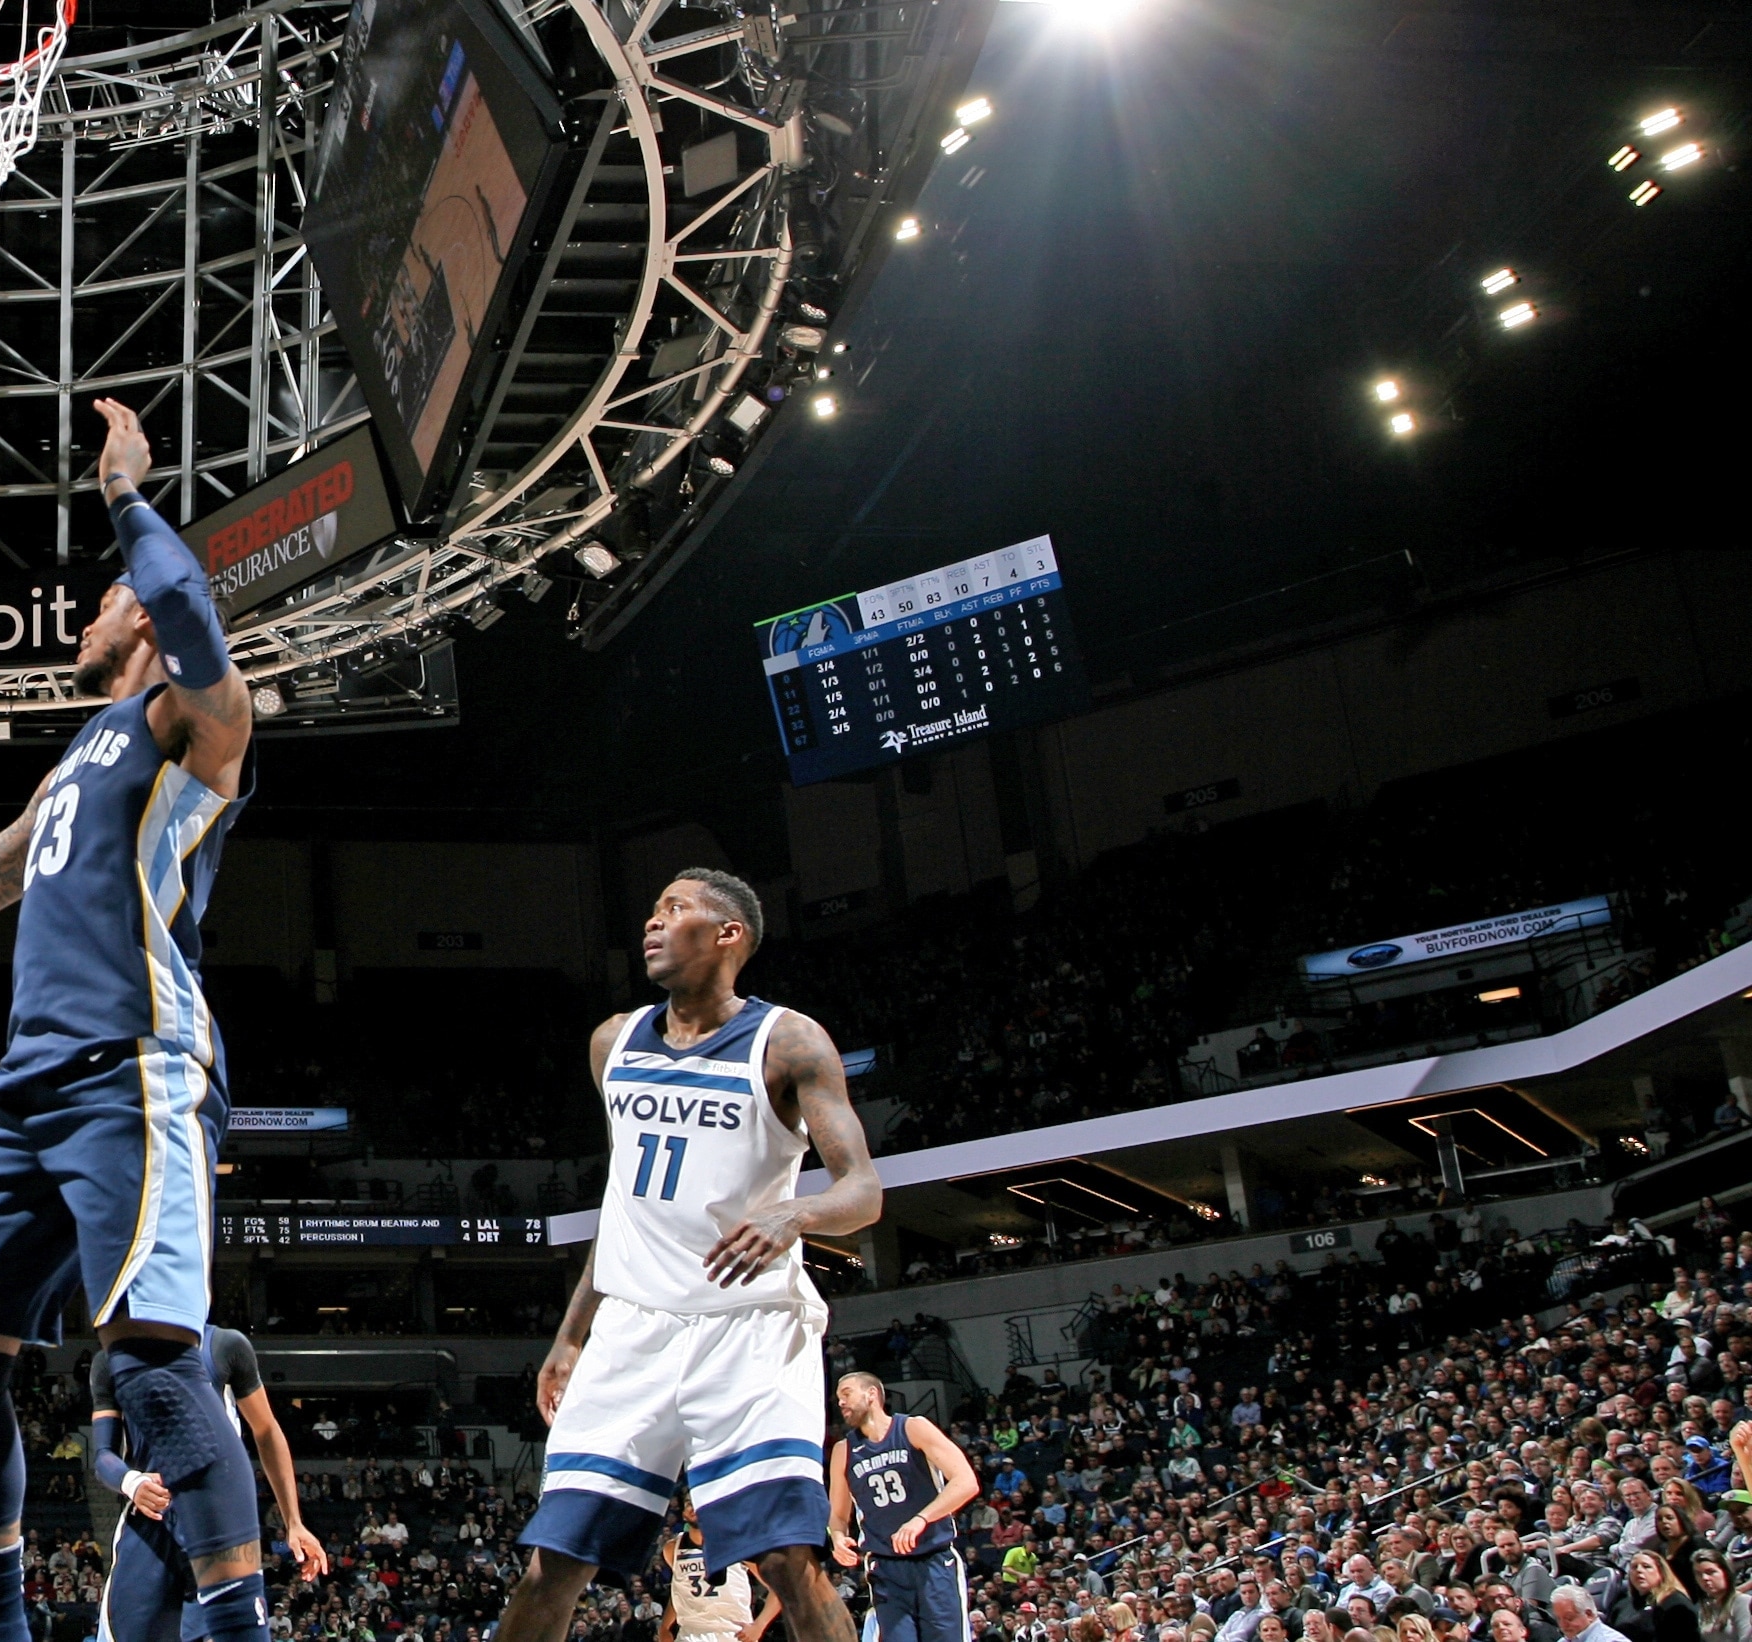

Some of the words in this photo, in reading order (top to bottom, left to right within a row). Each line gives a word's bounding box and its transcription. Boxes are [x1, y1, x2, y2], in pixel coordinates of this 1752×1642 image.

[207, 460, 354, 575] FEDERATED
[946, 568, 967, 579] REB
[974, 560, 990, 571] AST
[1002, 553, 1015, 562] TO
[871, 610, 885, 621] 43
[899, 601, 913, 612] 50
[926, 592, 941, 604] 83
[954, 583, 968, 596] 10
[961, 600, 978, 612] AST
[983, 593, 1004, 605] REB
[1030, 579, 1050, 591] PTS
[817, 660, 835, 673] 3/4
[862, 648, 878, 659] 1/1
[906, 634, 925, 647] 2/2
[821, 676, 839, 688] 1/3
[866, 663, 883, 675] 1/2
[910, 650, 928, 662] 0/0
[825, 691, 842, 703] 1/5
[869, 679, 886, 691] 0/1
[914, 665, 932, 678] 3/4
[828, 707, 846, 720] 2/4
[873, 694, 890, 706] 1/1
[917, 681, 936, 694] 0/0
[832, 722, 850, 734] 3/5
[876, 710, 894, 722] 0/0
[921, 697, 940, 709] 0/0
[907, 718, 952, 738] Treasure
[953, 704, 987, 726] Island
[1415, 933, 1438, 944] YOUR
[1440, 923, 1492, 940] NORTHLAND
[1494, 916, 1519, 927] FORD
[1520, 908, 1562, 922] DEALERS
[1426, 919, 1555, 954] BUYFORDNOW.COM
[231, 1117, 307, 1126] FORDNOW.COM
[608, 1093, 742, 1130] WOLVES
[632, 1132, 688, 1201] 11
[222, 1217, 232, 1225] 12
[305, 1220, 350, 1228] RHYTHMIC
[477, 1219, 499, 1229] LAL
[525, 1219, 541, 1229] 78
[477, 1232, 500, 1242] DET
[525, 1233, 541, 1242] 87
[1306, 1232, 1336, 1248] 106
[853, 1449, 909, 1479] MEMPHIS
[868, 1470, 907, 1508] 33
[679, 1563, 706, 1572] WOL
